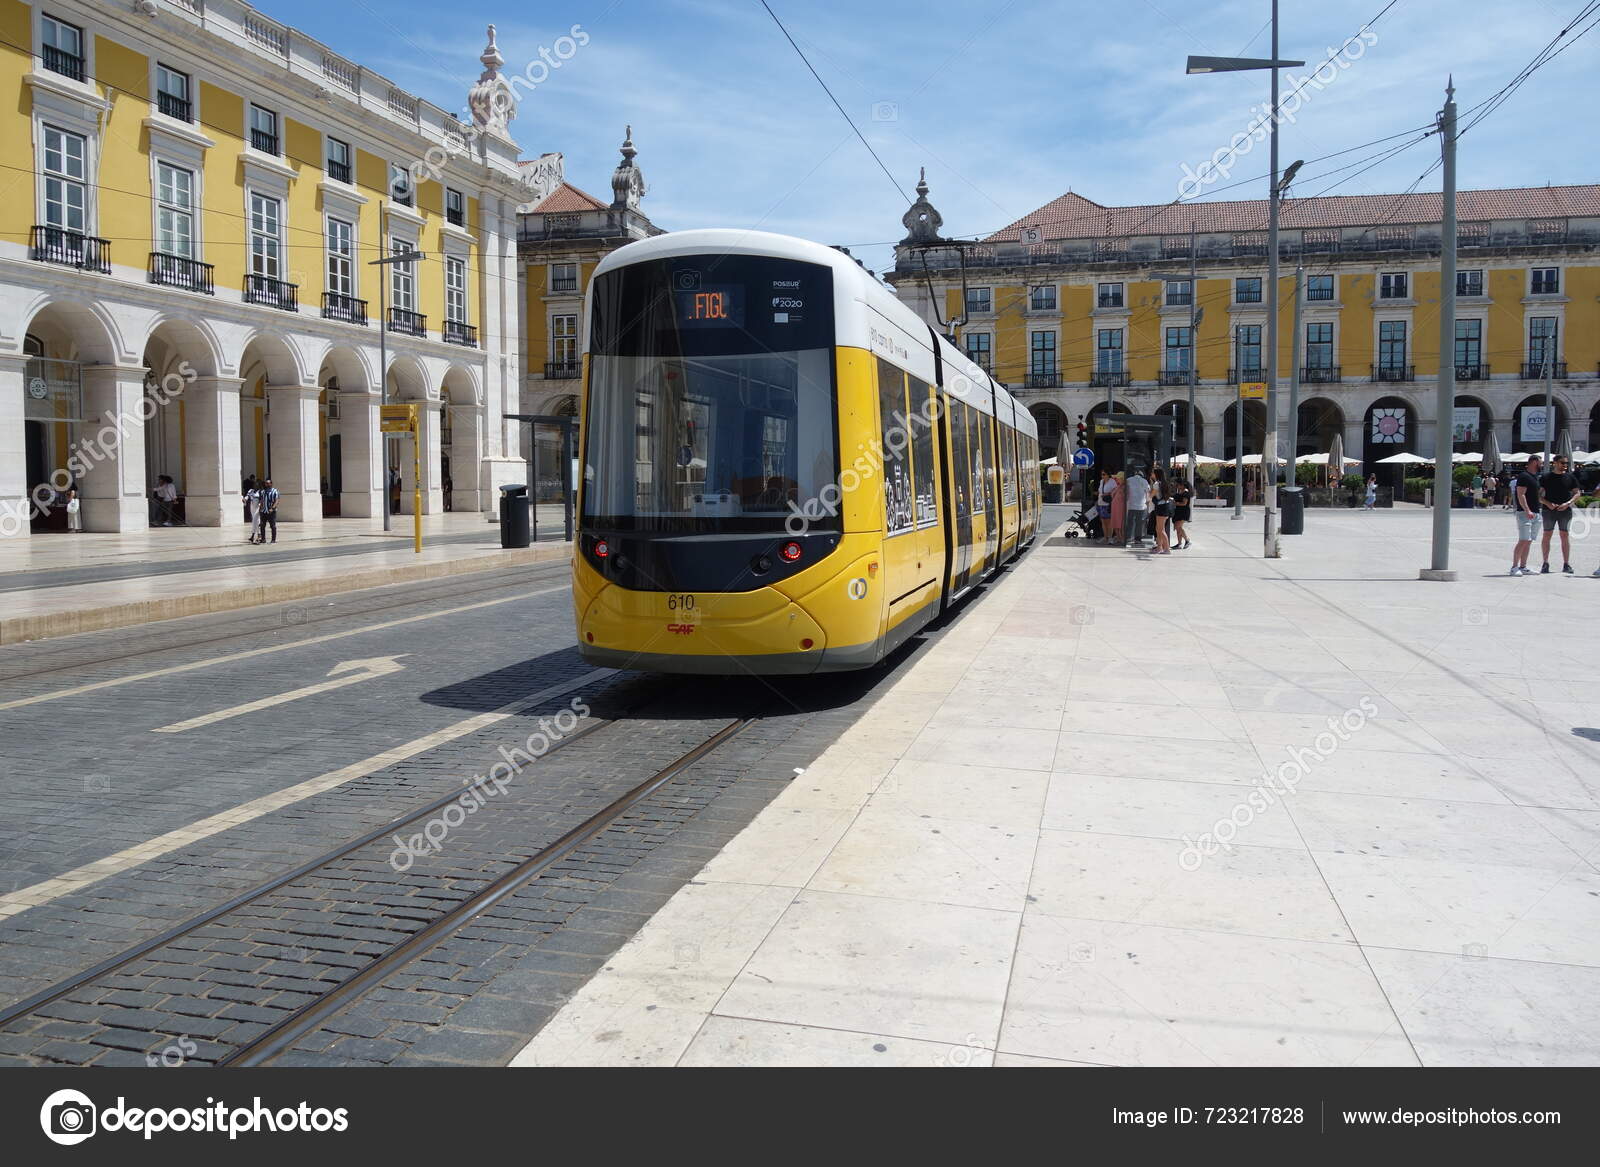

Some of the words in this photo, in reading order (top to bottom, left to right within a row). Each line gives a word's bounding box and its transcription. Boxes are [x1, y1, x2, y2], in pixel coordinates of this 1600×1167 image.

[1026, 230, 1037, 240] 15
[780, 300, 803, 308] 2020
[668, 594, 695, 610] 610
